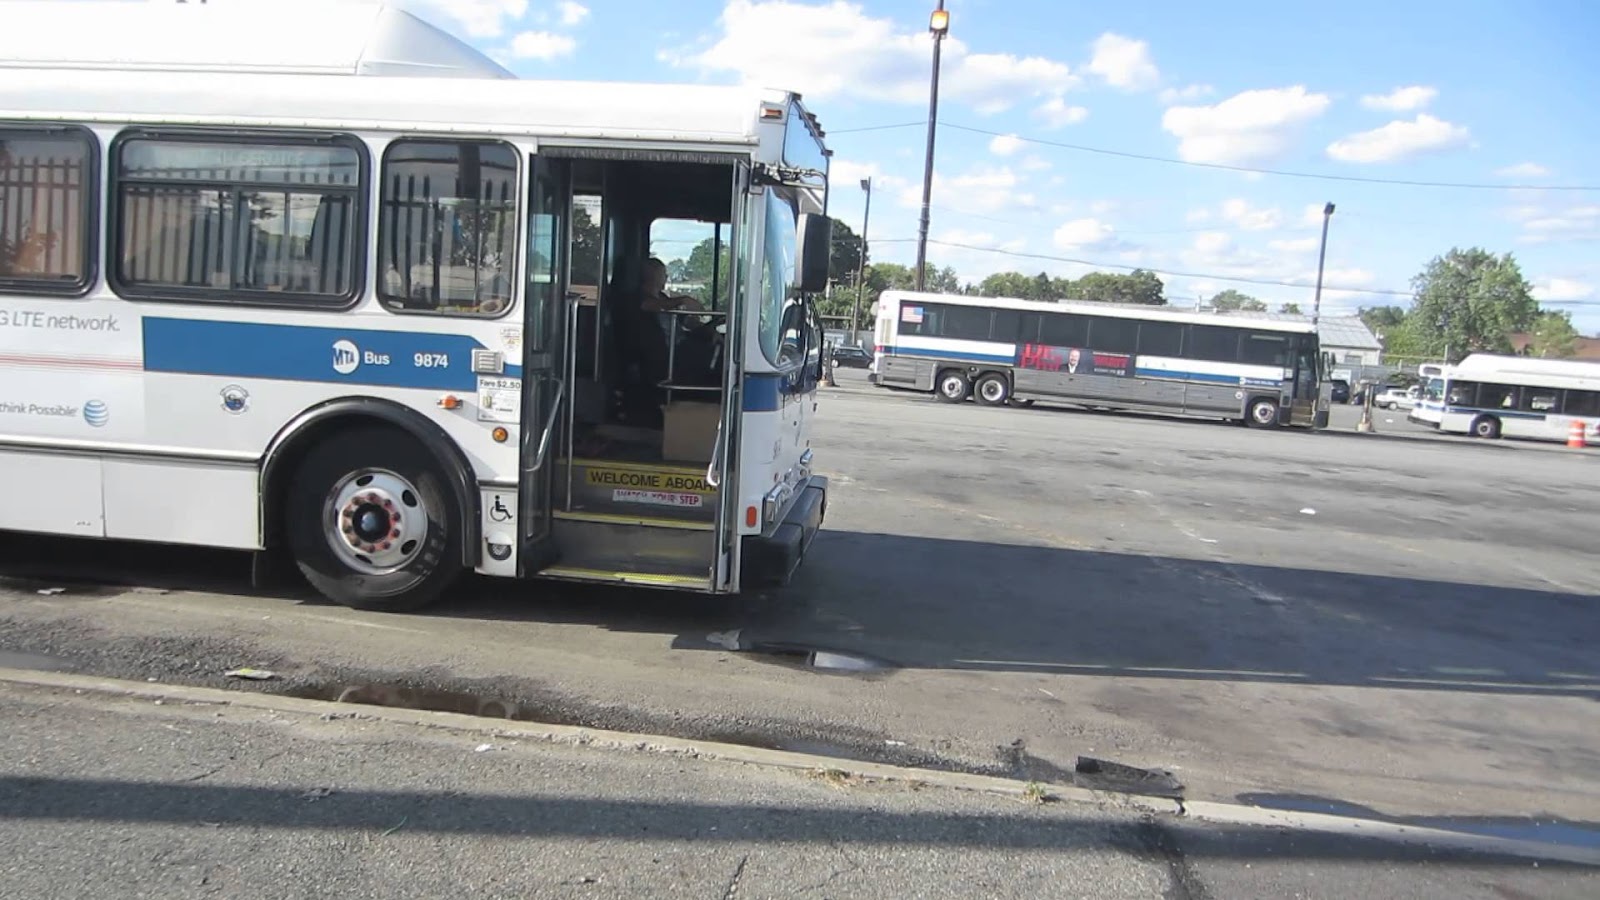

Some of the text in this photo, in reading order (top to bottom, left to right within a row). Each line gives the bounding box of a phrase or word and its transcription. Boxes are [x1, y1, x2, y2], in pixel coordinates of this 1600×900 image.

[12, 311, 45, 328] LTE
[47, 315, 121, 332] network.
[364, 351, 391, 366] Bus
[413, 353, 449, 368] 9874
[480, 379, 496, 388] Fare
[28, 404, 76, 417] Possible
[591, 470, 717, 492] WELCOME ABOAR
[680, 495, 699, 505] STEP
